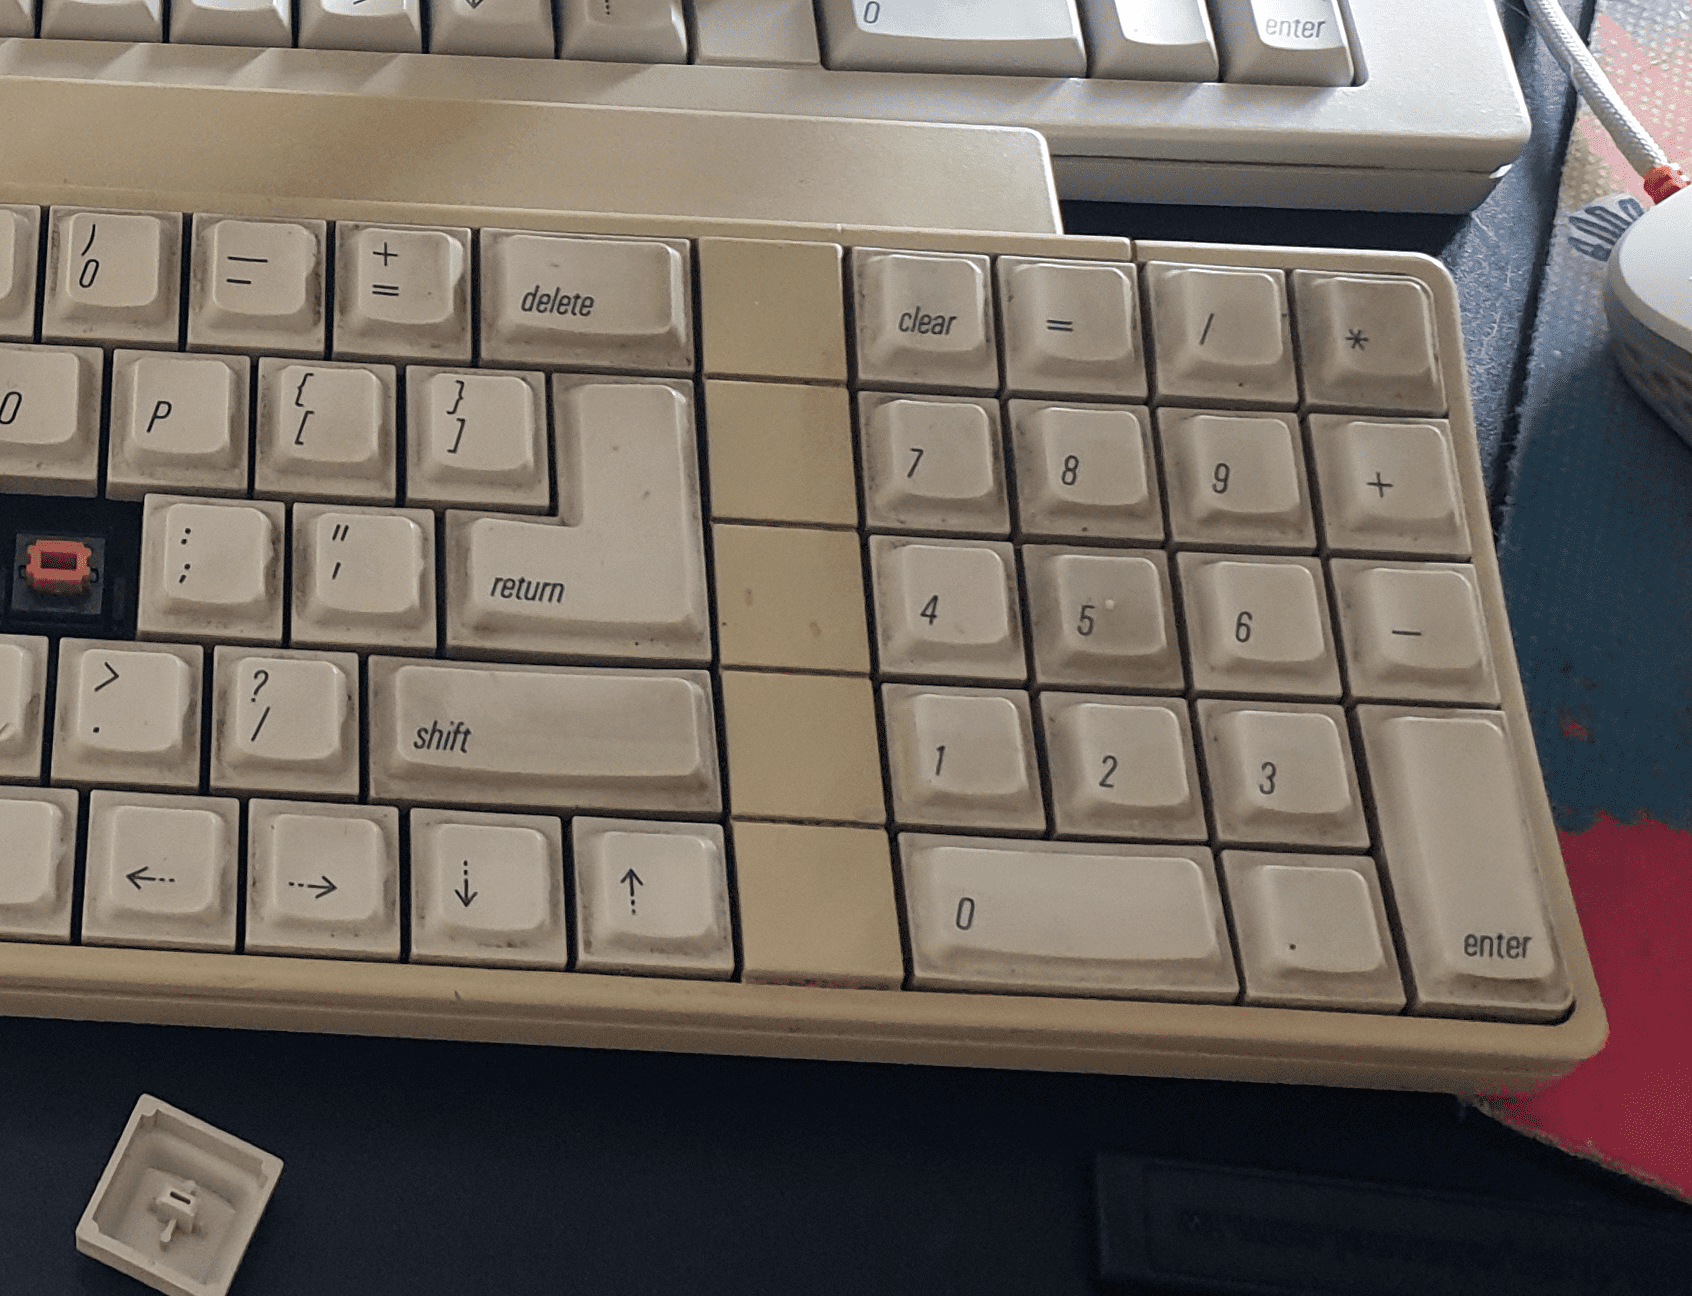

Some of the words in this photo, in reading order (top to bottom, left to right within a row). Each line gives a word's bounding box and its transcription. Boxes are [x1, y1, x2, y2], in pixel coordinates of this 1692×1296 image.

[863, 0, 881, 24] 0
[1265, 18, 1327, 39] enter
[80, 223, 96, 257] )
[372, 242, 399, 267] +
[78, 258, 100, 289] 0
[371, 284, 400, 297] =
[520, 284, 595, 317] delete
[898, 305, 958, 336] clear
[1046, 319, 1074, 332] =
[1199, 312, 1215, 346] /
[294, 372, 315, 408] {
[446, 379, 465, 415] }
[146, 400, 173, 434] P
[294, 410, 315, 446] [
[446, 417, 466, 454] ]
[907, 447, 924, 478] 7
[1061, 454, 1080, 486] 8
[1211, 462, 1231, 495] 9
[1366, 472, 1394, 498] +
[490, 576, 565, 604] return
[919, 594, 939, 626] 4
[1076, 604, 1096, 637] 5
[1235, 610, 1253, 643] 6
[94, 661, 120, 693] >
[250, 669, 269, 703] ?
[250, 706, 271, 742] /
[413, 720, 472, 754] shift
[935, 745, 946, 776] 1
[1098, 754, 1118, 789] 2
[1258, 761, 1277, 795] 3
[955, 896, 975, 931] 0
[1463, 933, 1533, 959] enter
